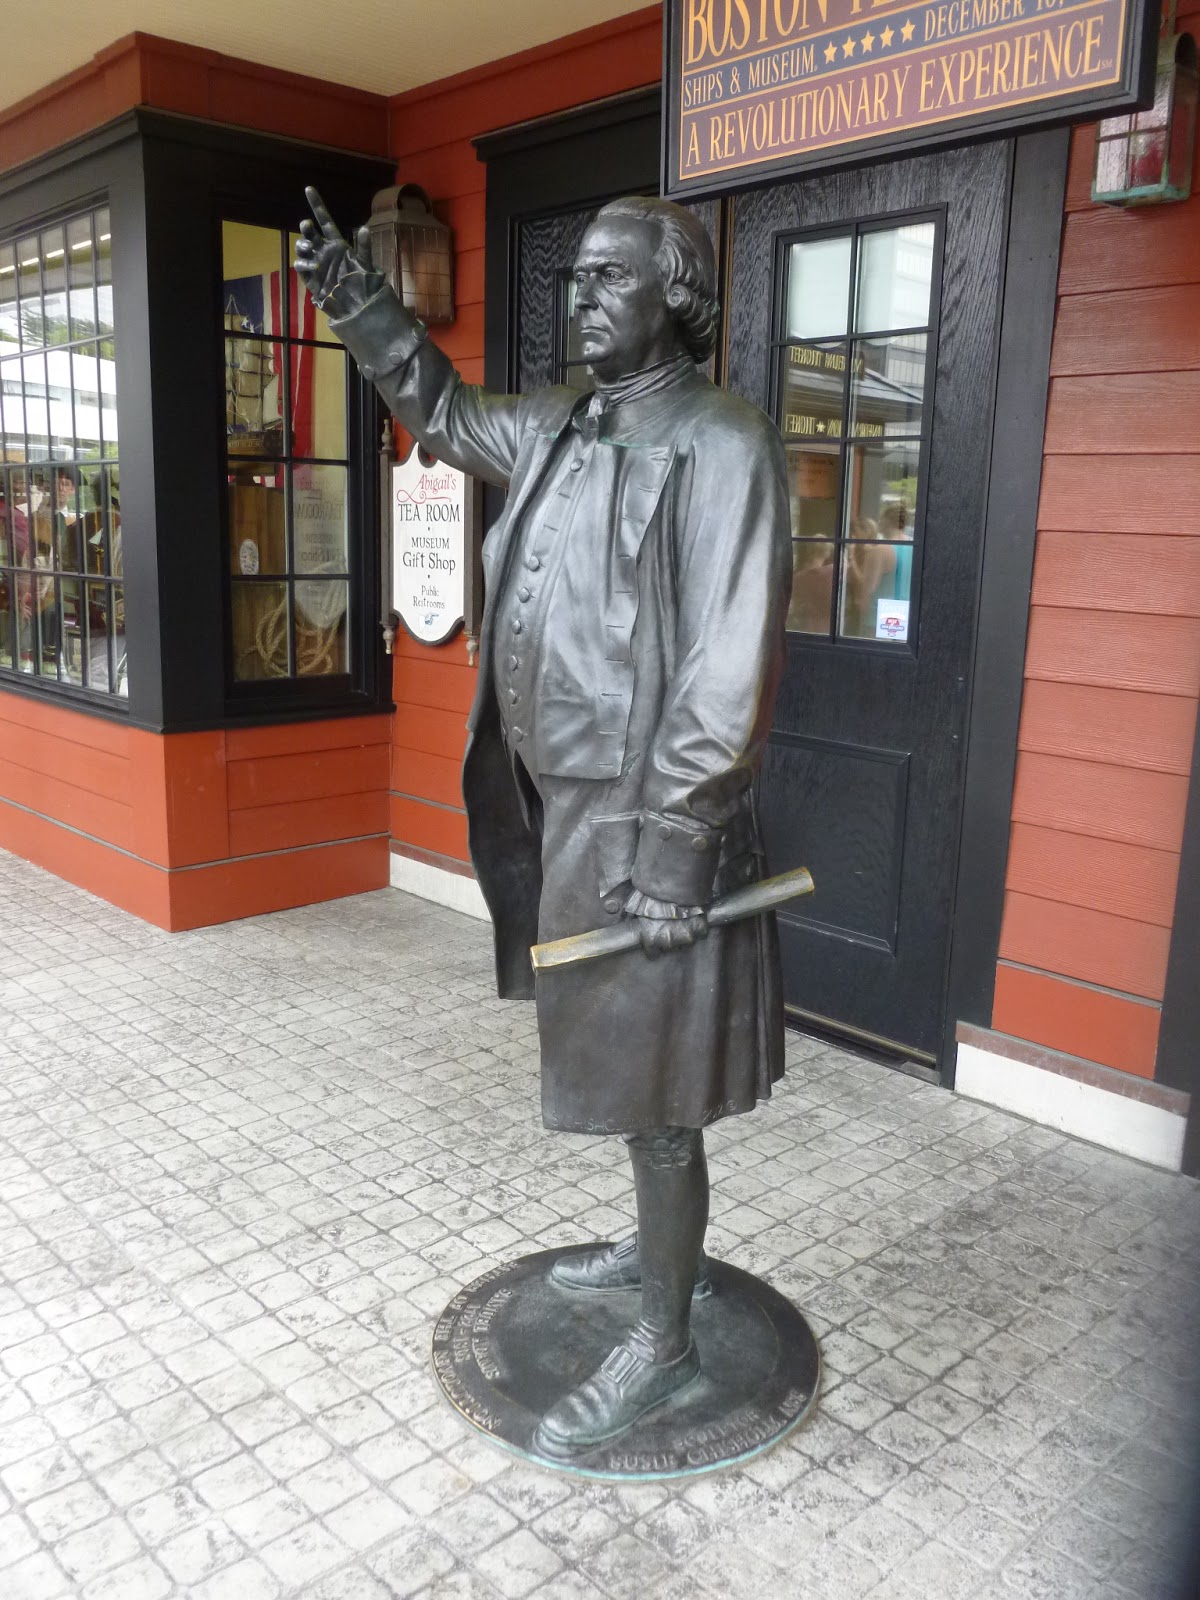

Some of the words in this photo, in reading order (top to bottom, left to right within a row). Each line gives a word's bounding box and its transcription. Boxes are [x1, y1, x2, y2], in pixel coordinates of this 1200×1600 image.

[684, 71, 724, 108] SHIPS
[730, 66, 742, 95] &
[685, 122, 702, 168] A
[709, 65, 913, 162] REVOLUTIONARY
[920, 15, 1104, 109] EXPERIENCE
[409, 474, 457, 497] Abigail's
[398, 504, 421, 522] TEA
[426, 504, 460, 522] ROOM
[411, 537, 450, 549] MUSEUM
[403, 552, 425, 568] Gift
[428, 553, 456, 575] Shop
[413, 596, 445, 609] Restrooms
[421, 585, 439, 597] Public
[450, 1294, 469, 1311] OF
[472, 1287, 512, 1333] SAMUEL
[434, 1315, 457, 1341] THE
[433, 1350, 500, 1431] REVOLUTION
